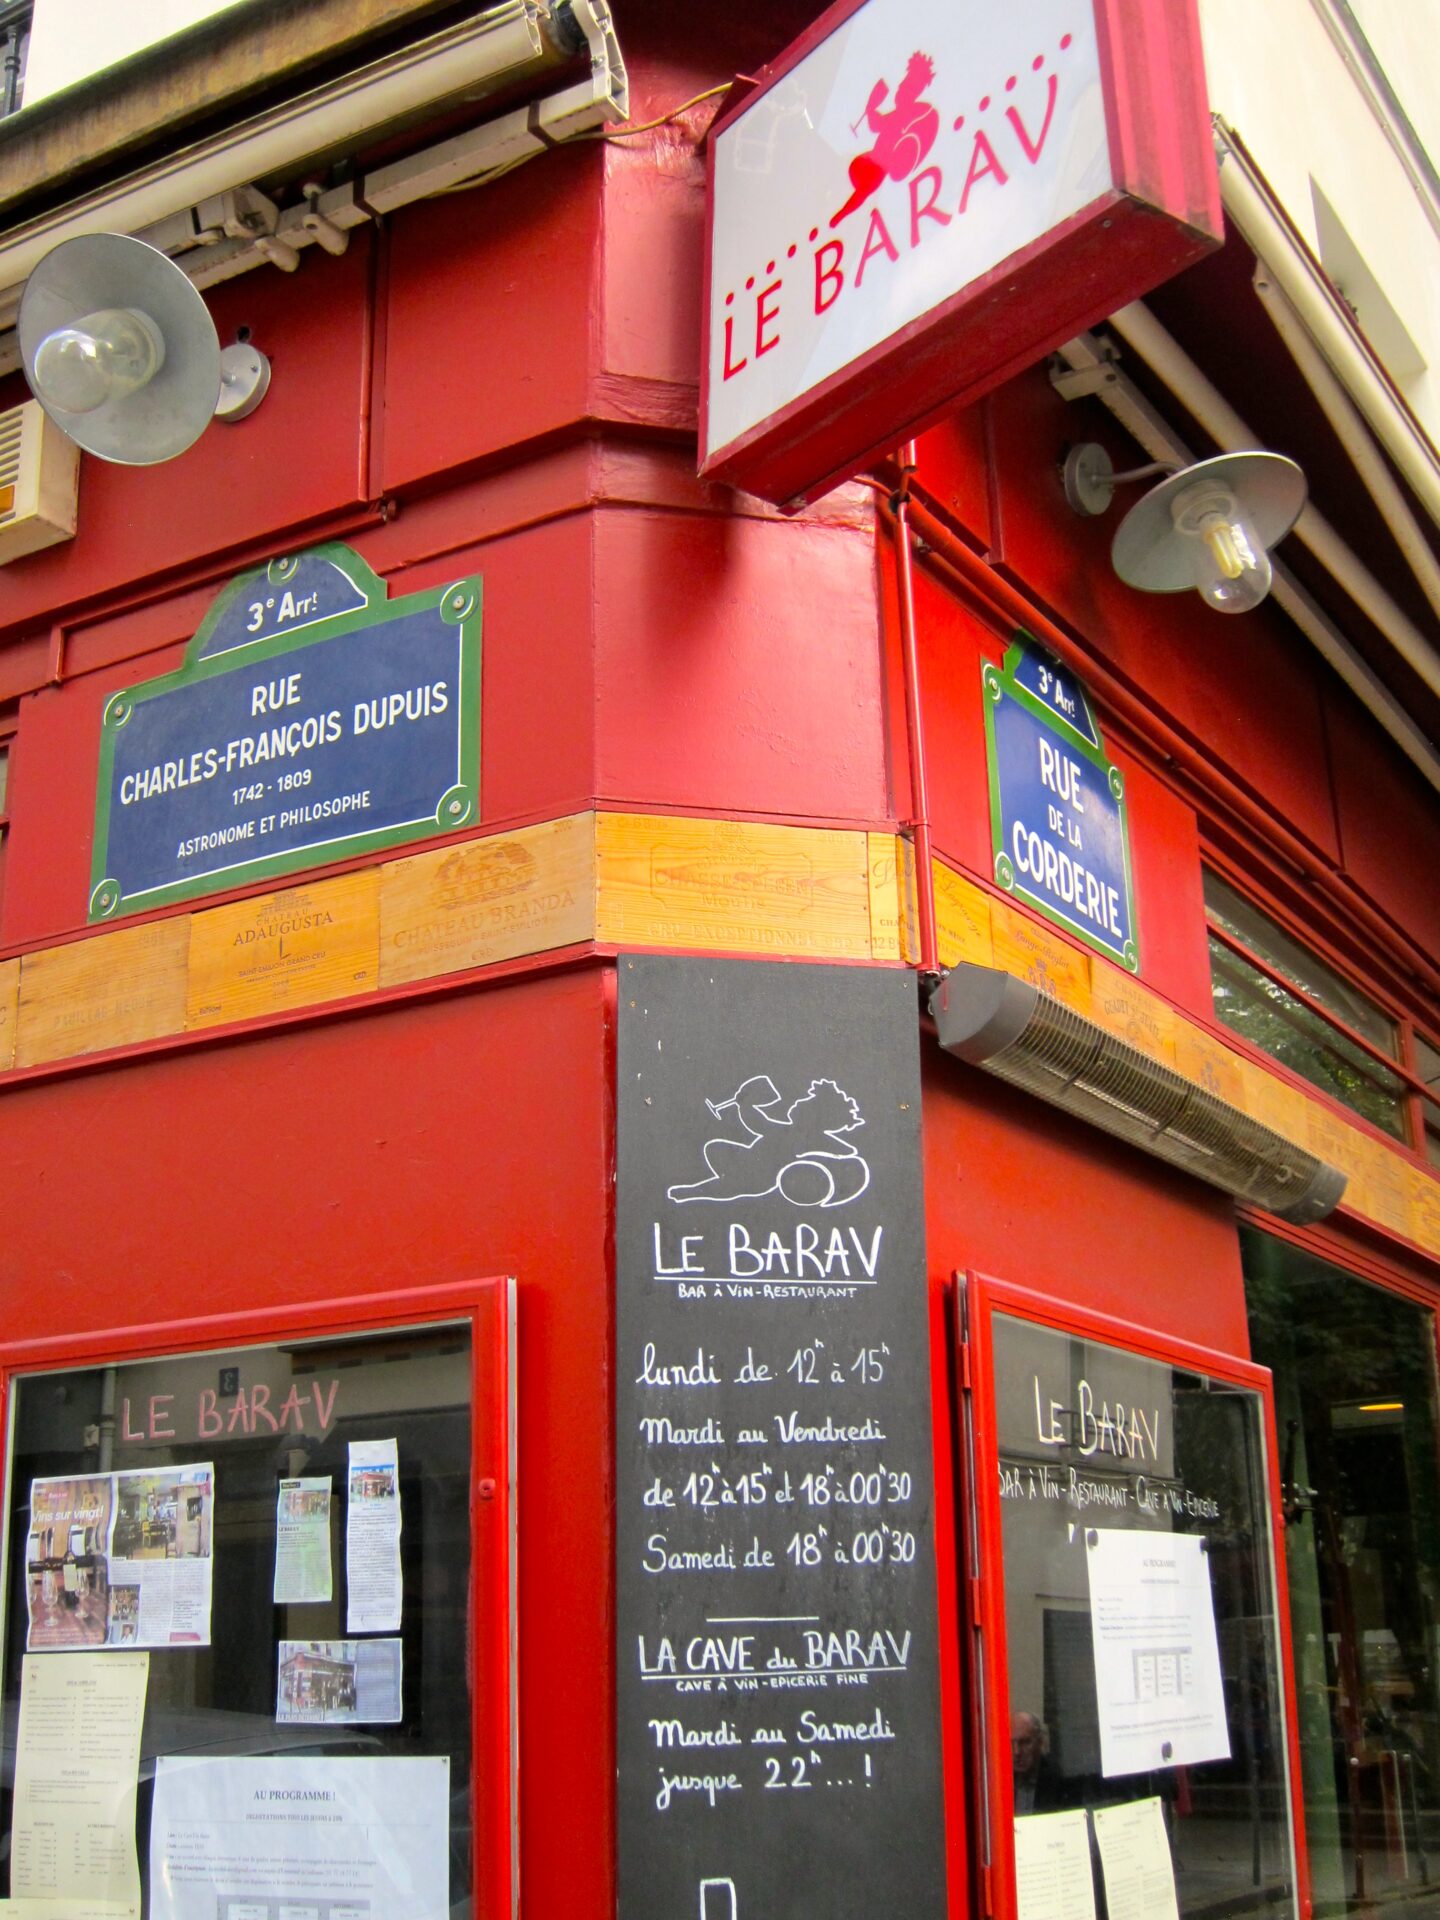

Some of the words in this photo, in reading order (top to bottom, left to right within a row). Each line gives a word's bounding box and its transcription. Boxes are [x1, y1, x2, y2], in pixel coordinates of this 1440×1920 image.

[722, 280, 784, 382] LE
[812, 74, 1057, 315] BARAV
[251, 673, 302, 716] RUE
[120, 711, 341, 805] CHARLES-FRANÇOIS
[354, 682, 448, 734] DUPUIS
[232, 783, 264, 805] 1742
[277, 769, 312, 794] 1809
[1039, 737, 1084, 813] RUE
[177, 822, 255, 858] ASTRONOME
[260, 817, 276, 834] ET
[280, 790, 370, 828] PHILOSOPHE
[1048, 804, 1064, 839] DE
[1068, 825, 1082, 850] LA
[1013, 820, 1122, 938] CORDERIE
[490, 889, 575, 925] BRANDA
[233, 912, 333, 945] ADAUGUSTA
[654, 1222, 704, 1273] LE
[729, 1223, 882, 1277] BARAV
[678, 1283, 706, 1298] BAR
[831, 1362, 845, 1383] à
[122, 1395, 176, 1441] LE
[198, 1380, 339, 1438] BARAV
[639, 1417, 725, 1444] Mardi
[737, 1430, 768, 1443] au
[774, 1411, 886, 1442] Vendredi
[1034, 1375, 1066, 1444] LE
[1077, 1379, 1159, 1461] BARAV
[643, 1478, 676, 1507] de
[722, 1479, 737, 1503] à
[775, 1471, 794, 1503] et
[835, 1482, 849, 1503] à
[55, 1511, 71, 1520] sur
[643, 1534, 736, 1572] Samedi
[744, 1536, 774, 1567] de
[835, 1542, 849, 1563] à
[638, 1635, 676, 1673] LA
[686, 1637, 755, 1671] CAVE
[766, 1647, 798, 1670] du
[803, 1630, 911, 1668] BARAV
[676, 1680, 711, 1692] CAVE
[648, 1719, 742, 1748] Mardi
[751, 1729, 787, 1744] au
[797, 1708, 895, 1743] Samedi
[253, 1790, 267, 1801] AU
[269, 1790, 332, 1801] PROGRAMME
[656, 1767, 742, 1811] jusque
